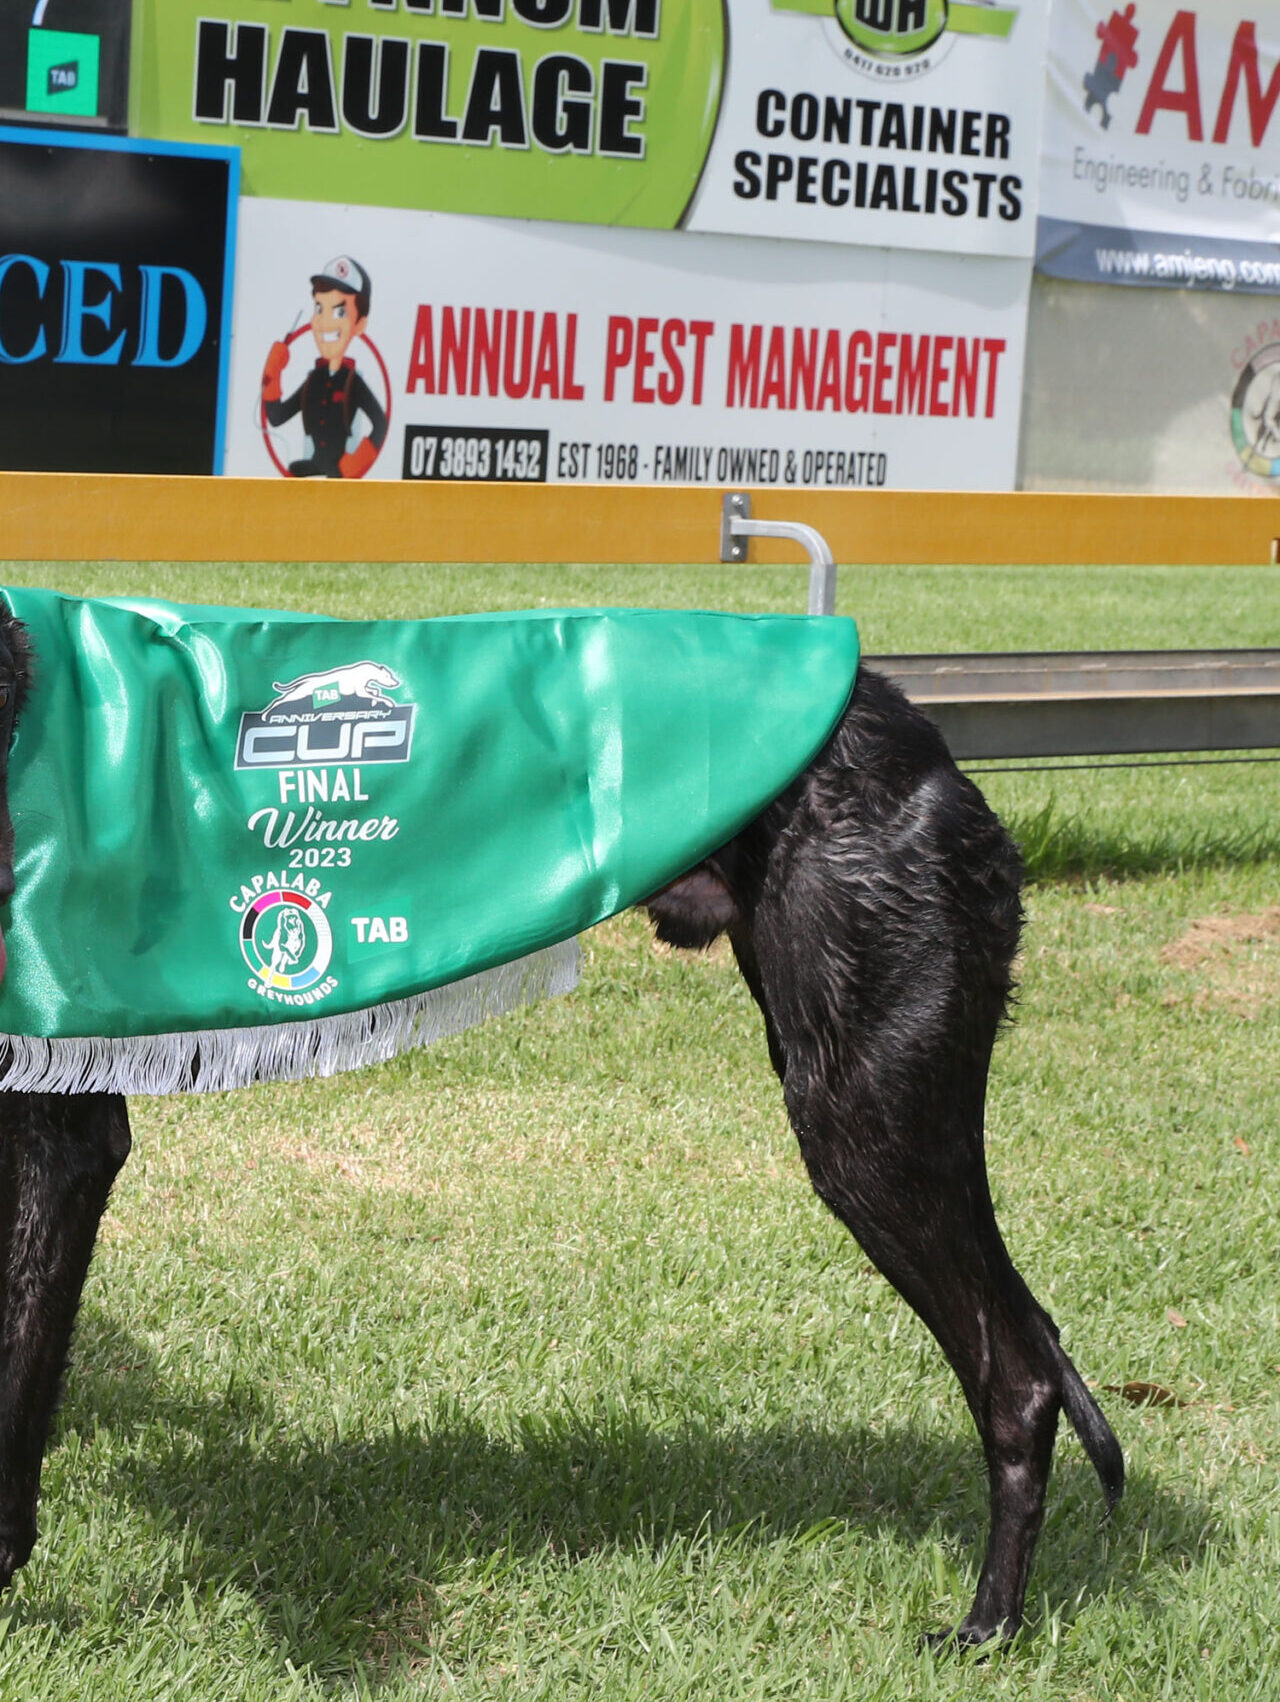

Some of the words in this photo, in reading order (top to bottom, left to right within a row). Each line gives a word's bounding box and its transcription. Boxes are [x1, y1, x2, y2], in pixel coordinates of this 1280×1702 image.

[50, 69, 76, 86] TAB
[194, 18, 647, 158] HAULAGE
[756, 89, 1011, 160] CONTAINER
[732, 150, 1023, 222] SPECIALISTS
[1073, 146, 1190, 203] Engineering
[1198, 163, 1213, 196] &
[405, 303, 585, 401] ANNUAL
[604, 316, 715, 407] PEST
[726, 324, 1007, 419] MANAGEMENT
[410, 436, 437, 476] 07
[439, 437, 491, 478] 3893
[495, 438, 541, 479] 1432
[557, 442, 591, 478] EST
[597, 443, 639, 480] 1968
[654, 446, 714, 482] FAMILY
[719, 449, 779, 484] OWNED
[784, 450, 797, 484] &
[803, 451, 887, 486] OPERATED
[270, 710, 392, 723] ANNIVERSARY
[314, 689, 339, 701] TAB
[242, 720, 407, 763] CUP
[278, 768, 369, 803] FINAL
[247, 806, 399, 848] Winner
[288, 847, 352, 868] 2023
[229, 870, 332, 913] CAPALABA
[351, 916, 409, 943] TAB
[248, 975, 339, 1006] GREYHOUNDS
